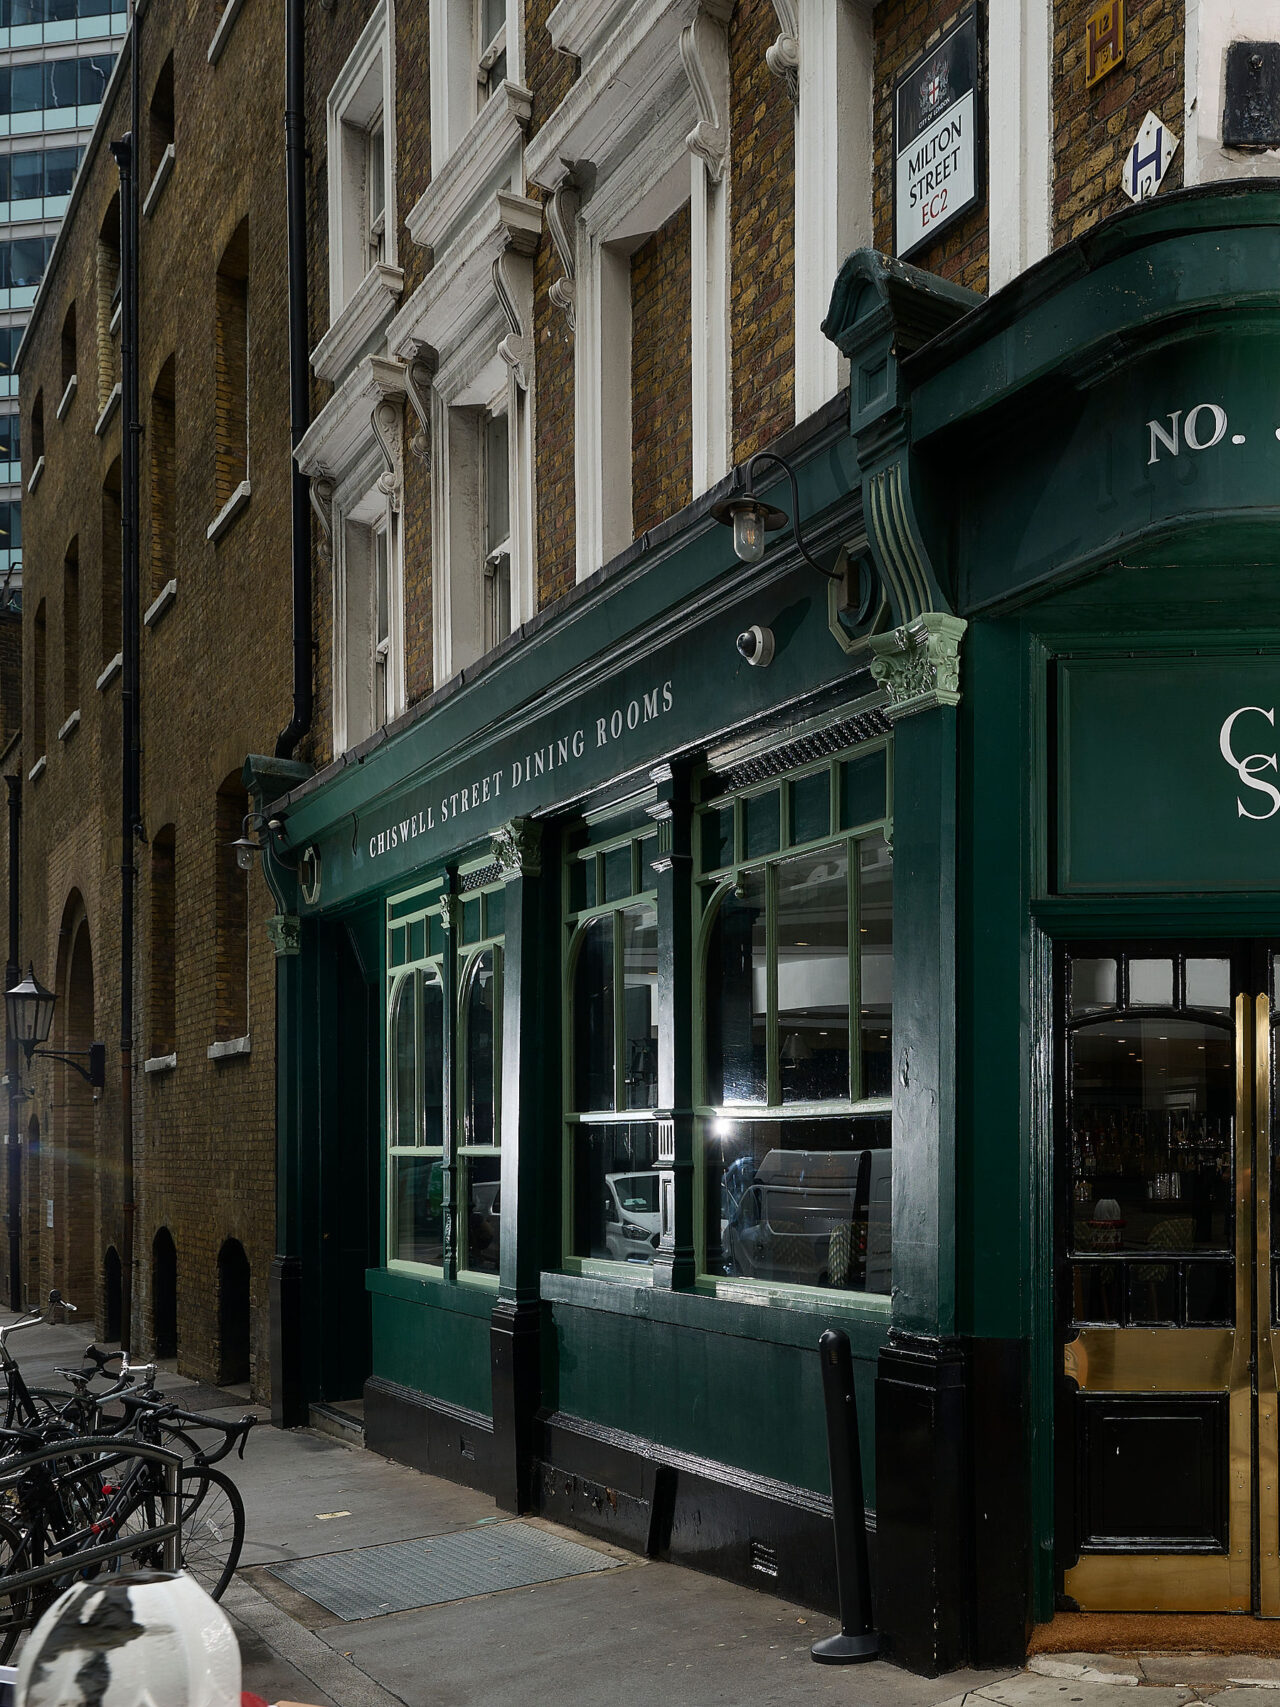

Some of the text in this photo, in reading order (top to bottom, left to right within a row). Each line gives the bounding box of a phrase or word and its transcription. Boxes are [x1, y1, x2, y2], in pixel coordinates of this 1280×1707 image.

[1099, 14, 1110, 35] 12
[918, 117, 928, 129] CITY
[933, 97, 951, 116] LONDON
[908, 115, 962, 181] MILTON
[909, 145, 961, 208] STREET
[1132, 126, 1163, 197] H
[921, 188, 948, 228] EC2
[1145, 403, 1246, 466] NO.
[369, 680, 673, 858] CHISWELL STREET DINING ROOMS
